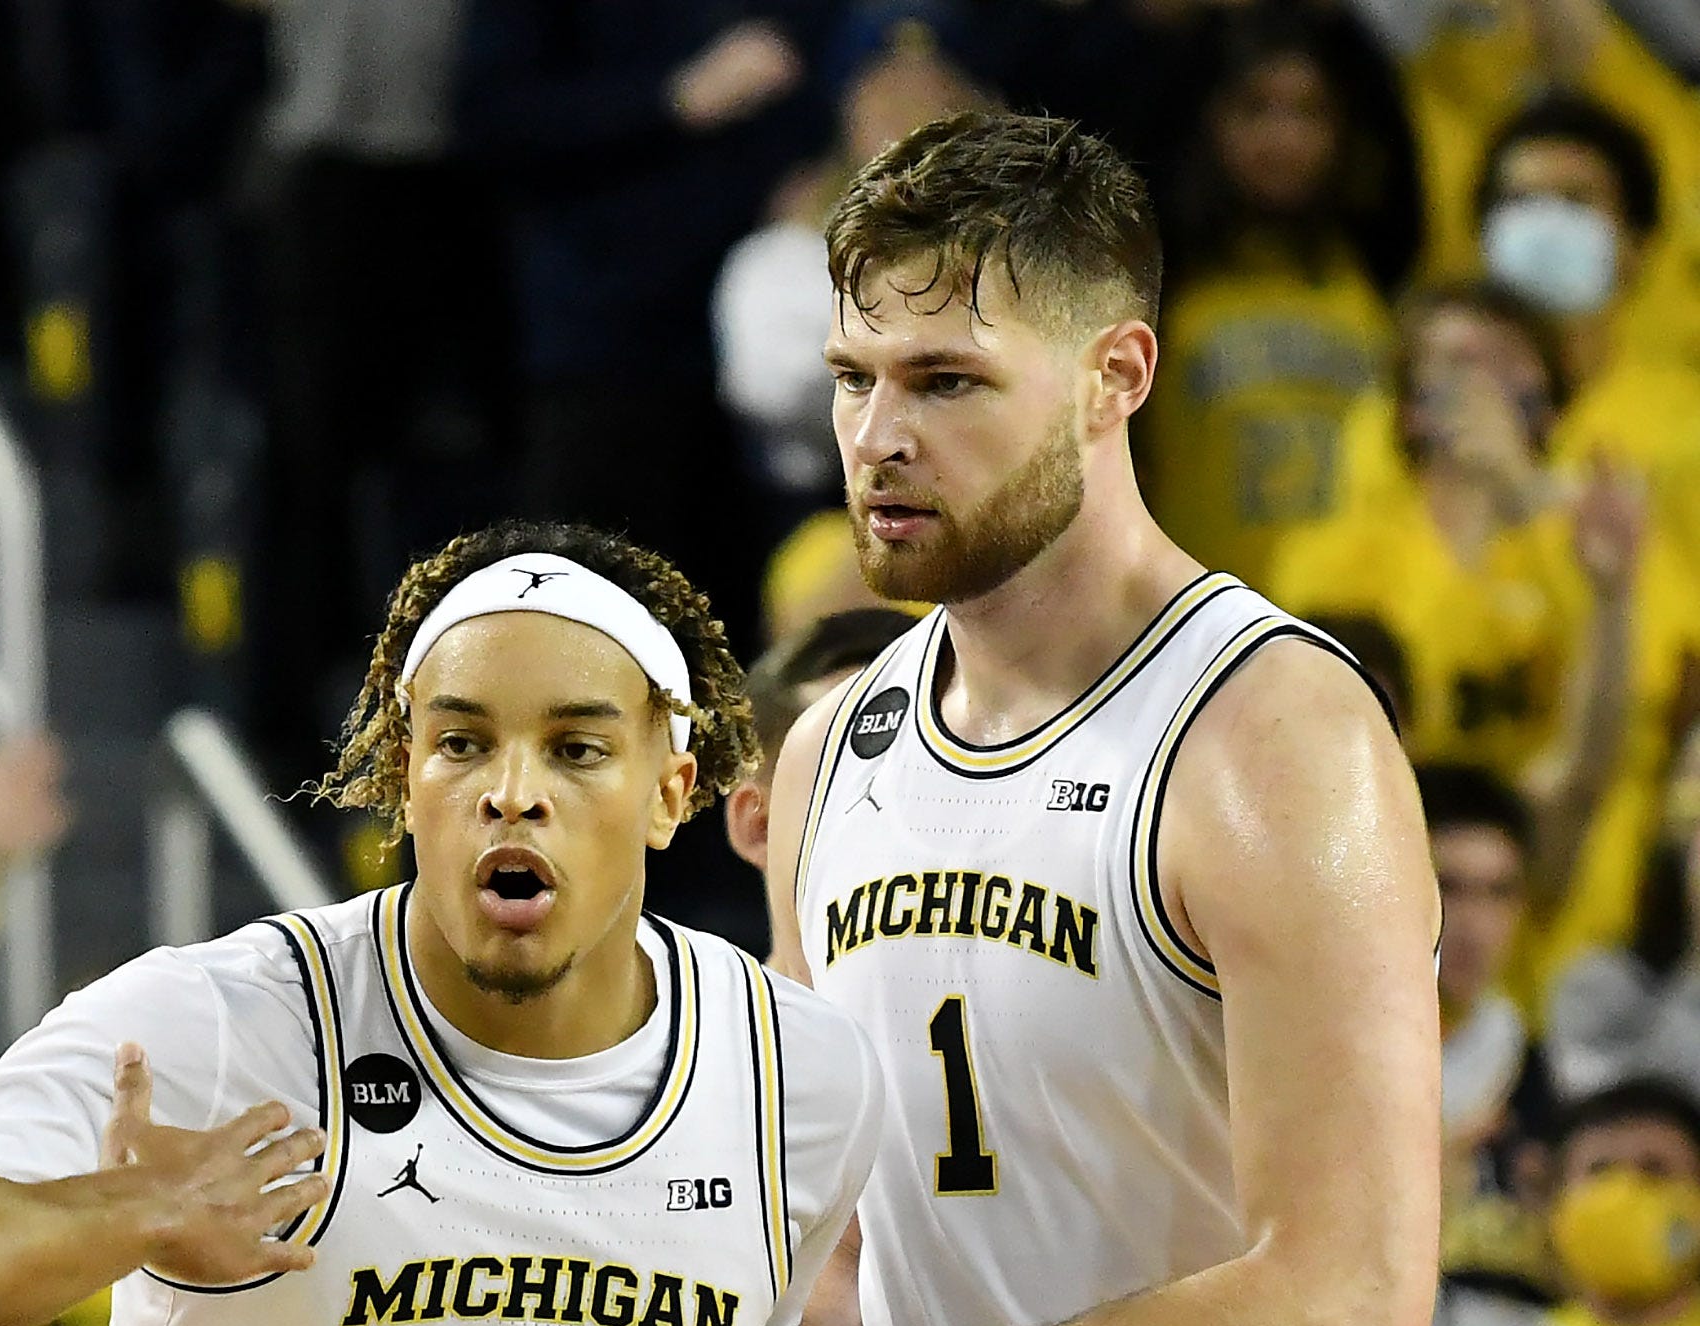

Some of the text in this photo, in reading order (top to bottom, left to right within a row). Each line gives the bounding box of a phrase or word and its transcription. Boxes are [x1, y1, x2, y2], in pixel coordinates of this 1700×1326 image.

[856, 709, 904, 735] BLM
[825, 867, 1100, 980] MICHIGAN
[350, 1081, 412, 1105] BLM
[928, 992, 1000, 1198] 1
